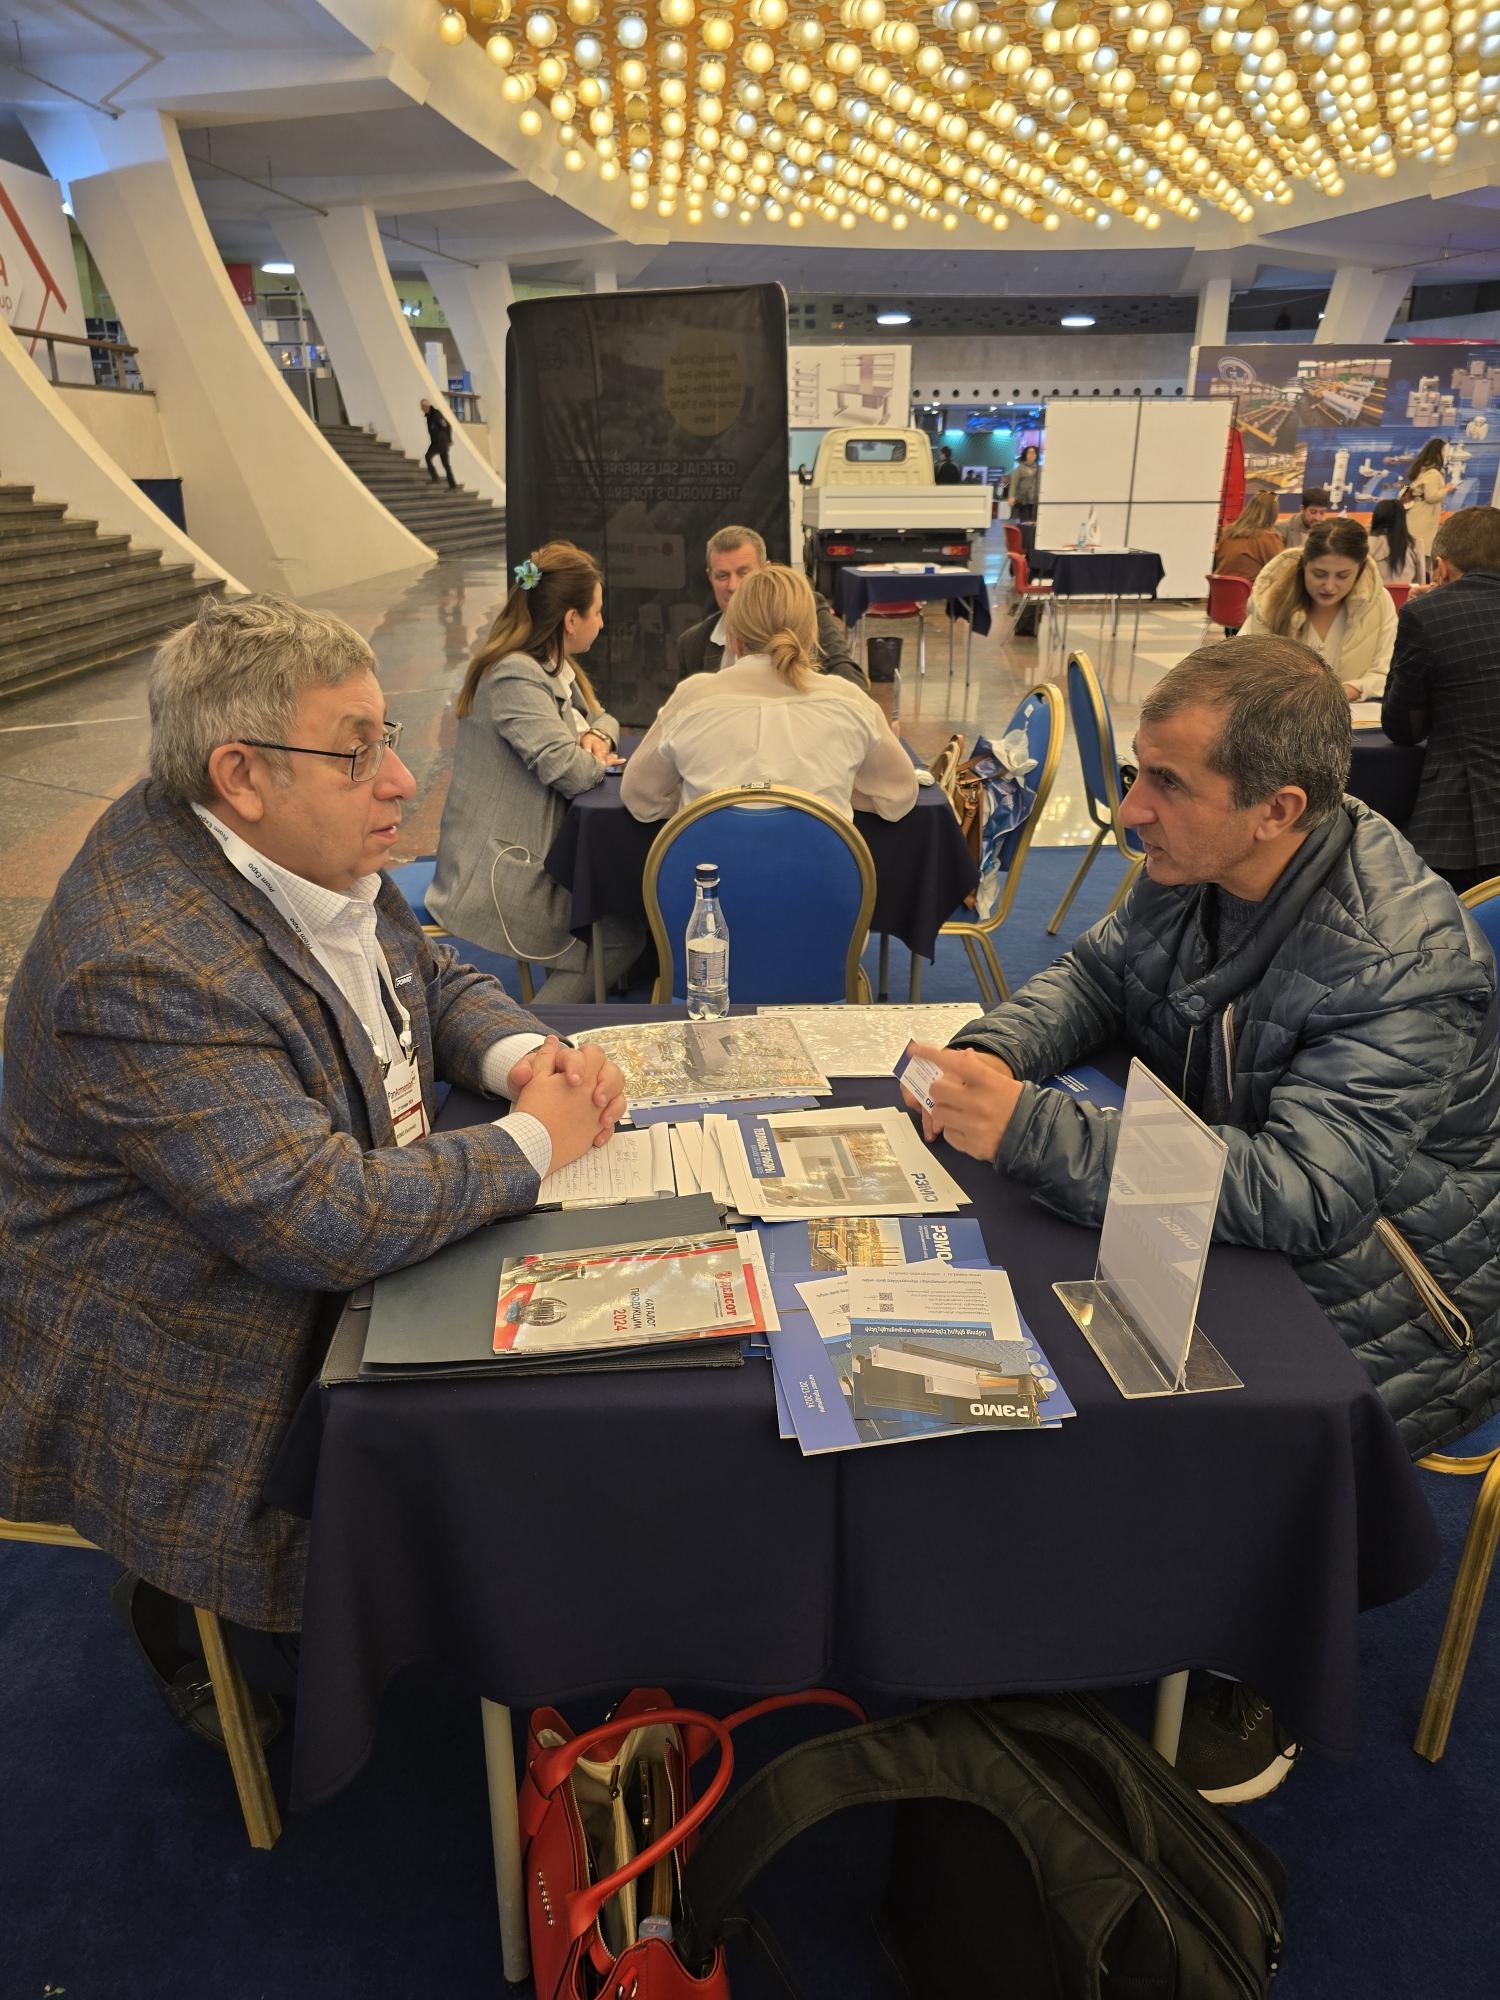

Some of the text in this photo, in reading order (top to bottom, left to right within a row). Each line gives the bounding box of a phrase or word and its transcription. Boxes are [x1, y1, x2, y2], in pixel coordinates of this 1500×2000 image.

[248, 863, 275, 893] Prom Expo
[290, 918, 301, 933] Expo
[911, 1172, 938, 1203] РЭМО
[930, 1225, 953, 1261] РЭМО
[630, 1288, 642, 1329] ПРОДУКЦИИ
[720, 1280, 736, 1315] ДЕЛСОТ
[613, 1309, 628, 1332] 2024
[800, 1381, 815, 1408] 2023-2024
[969, 1403, 1030, 1418] РЭМО
